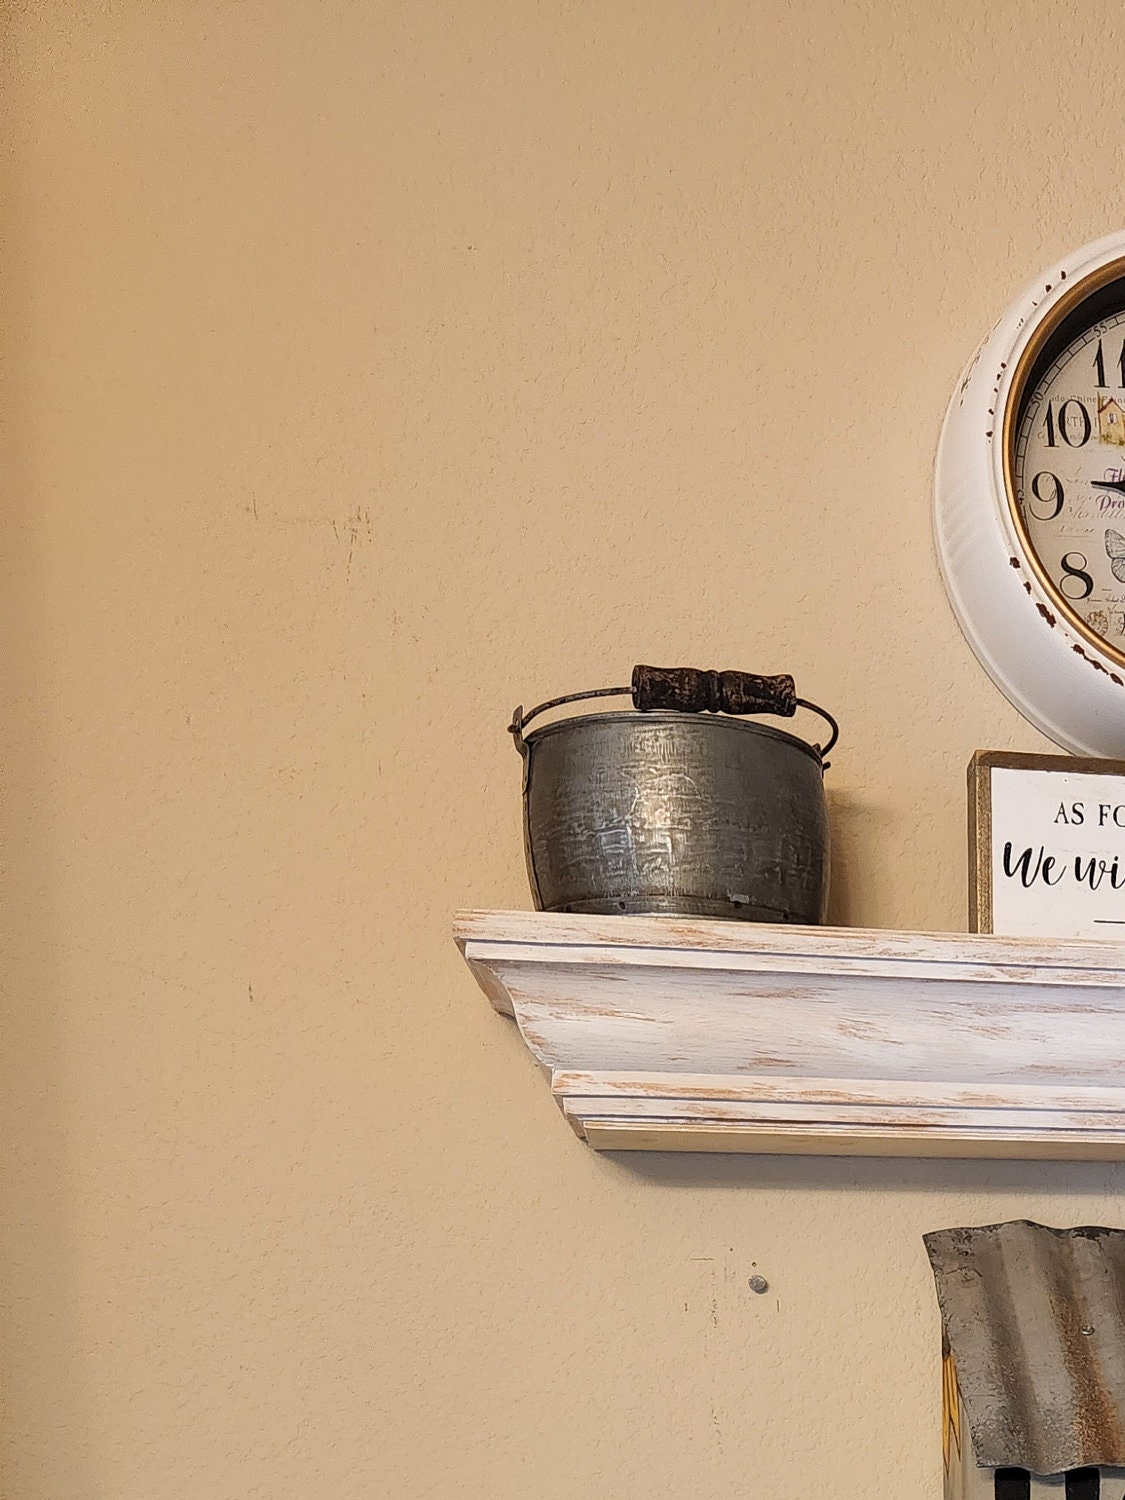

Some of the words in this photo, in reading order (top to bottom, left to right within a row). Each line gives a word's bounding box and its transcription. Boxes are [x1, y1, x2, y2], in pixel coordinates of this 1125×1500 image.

[1093, 321, 1108, 338] 55
[1042, 399, 1092, 448] 10
[1029, 471, 1064, 521] 9
[1060, 551, 1094, 600] 8
[1053, 802, 1086, 825] AS
[1003, 841, 1066, 888] We
